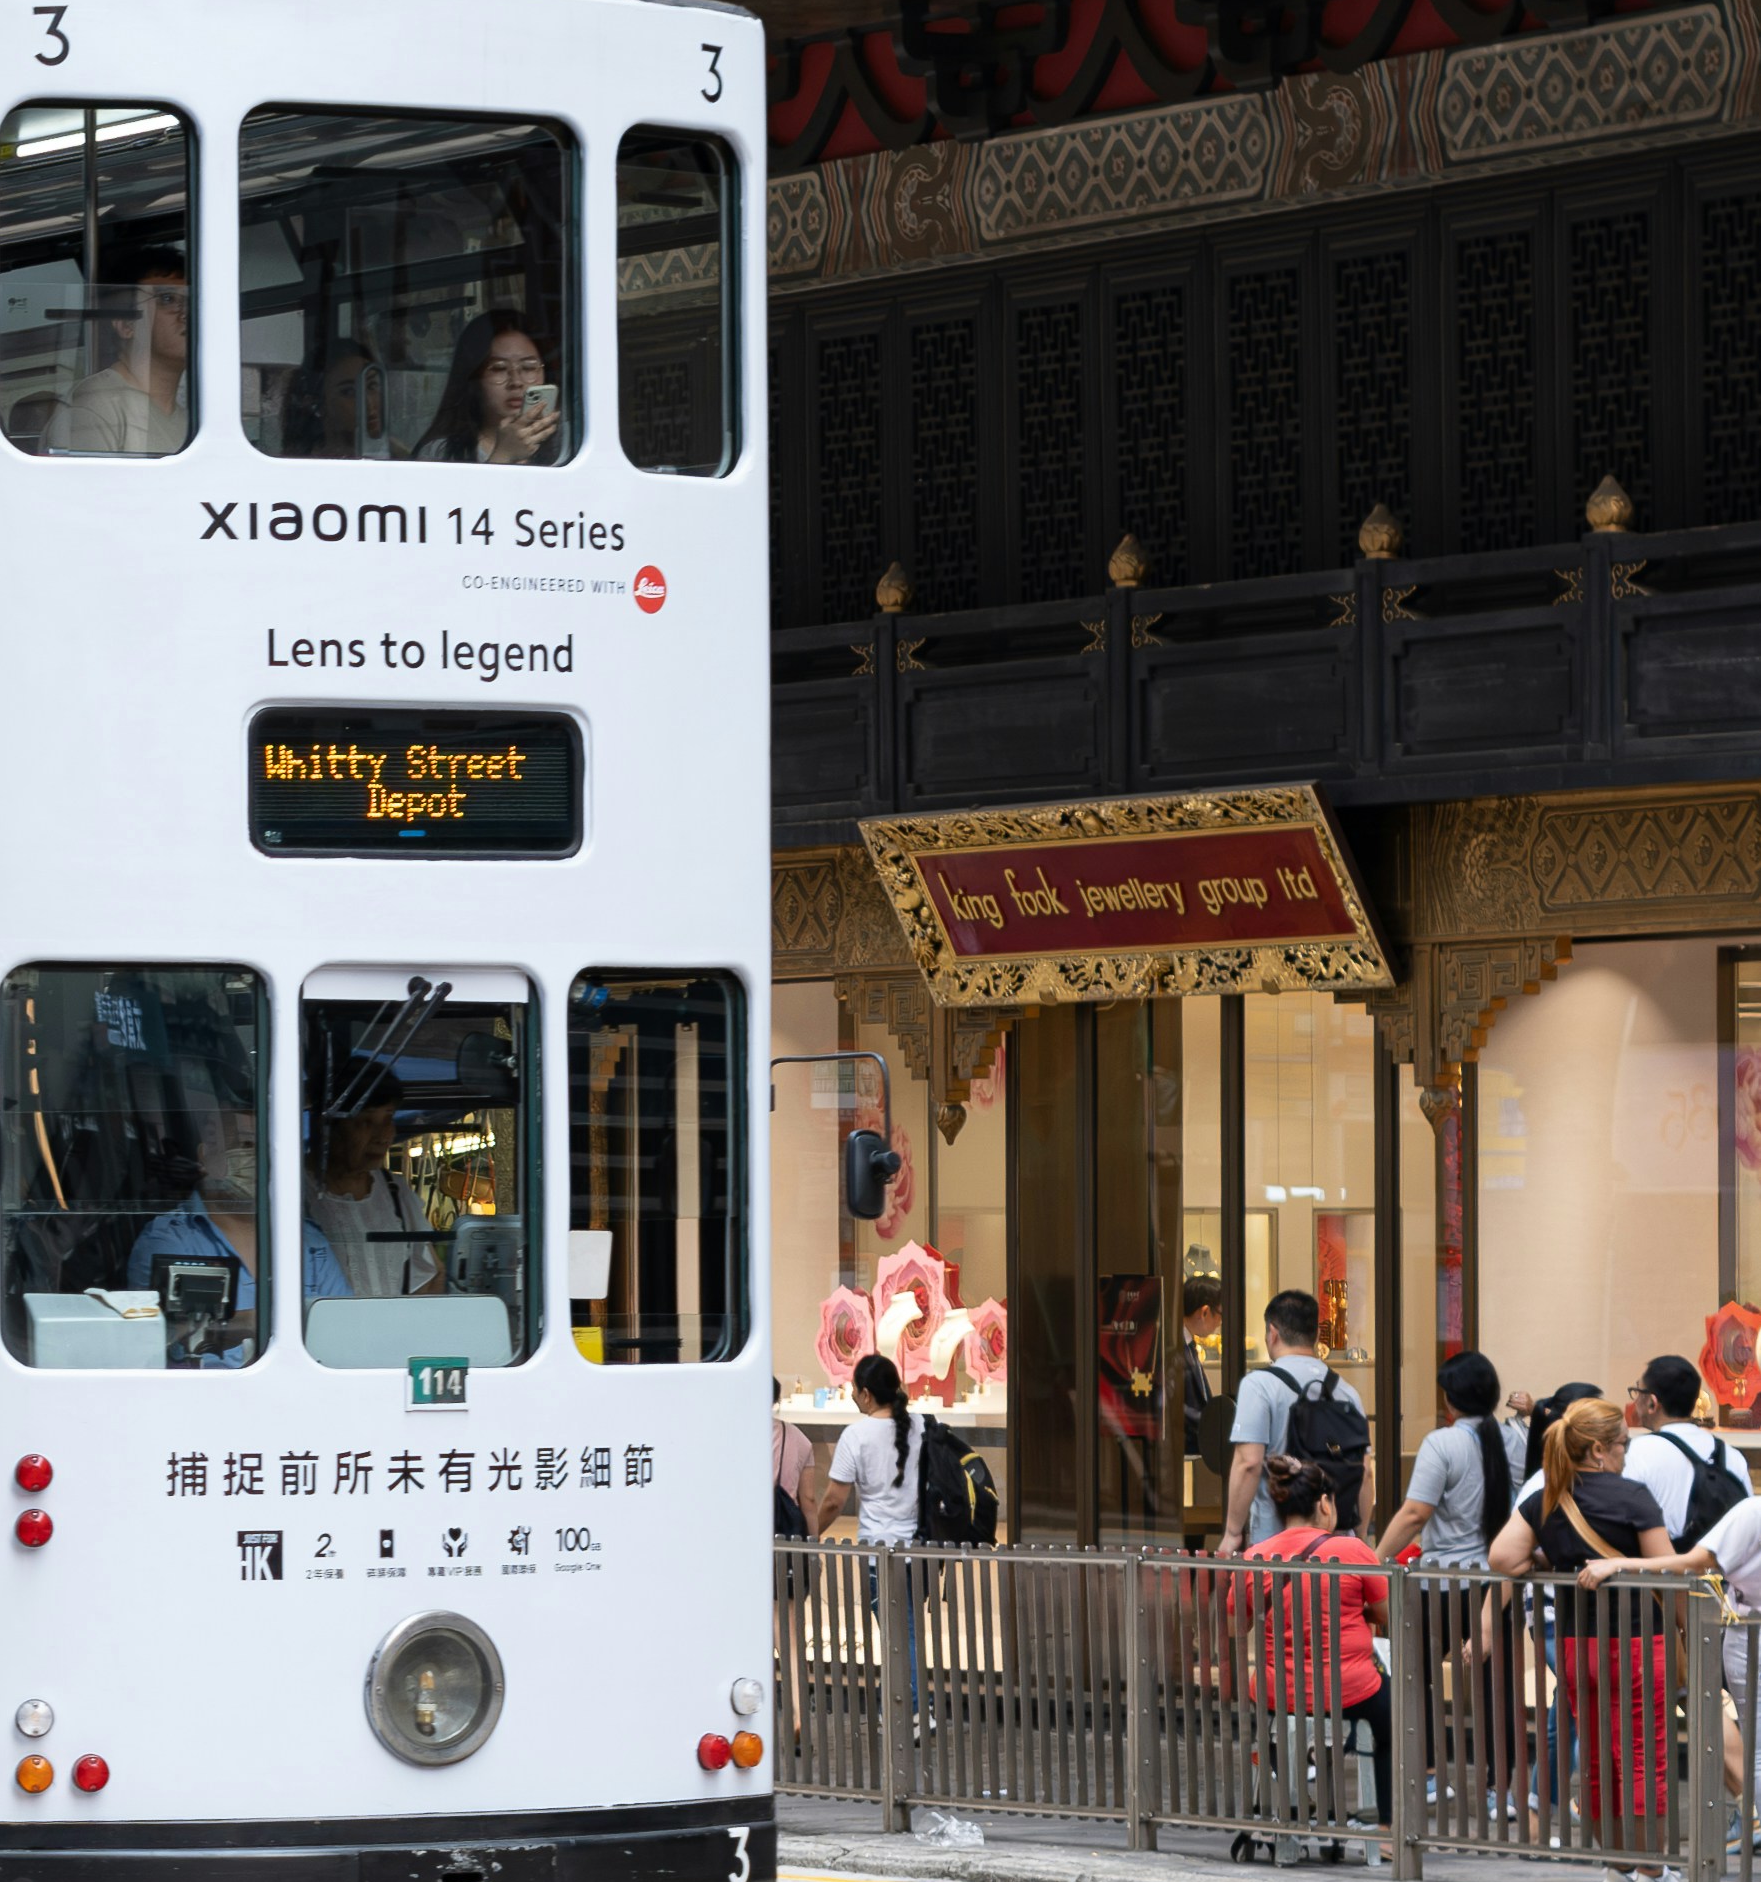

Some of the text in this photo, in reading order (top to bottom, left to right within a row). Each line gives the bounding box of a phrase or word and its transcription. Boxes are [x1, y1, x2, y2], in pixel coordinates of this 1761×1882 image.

[32, 5, 70, 67] 3
[700, 43, 723, 104] 3
[448, 507, 495, 546] 14
[515, 508, 625, 552] Series
[462, 575, 585, 593] CO-ENGINEERED
[590, 580, 626, 594] WITH
[268, 628, 573, 683] Lens to legend
[264, 744, 527, 783] Whitty Street
[366, 783, 468, 822] Depot
[938, 865, 1320, 929] king fook jewellery group ltd
[418, 1366, 463, 1396] 114
[166, 1443, 654, 1497] 捕捉前所未有光影細節
[238, 1545, 274, 1581] HK
